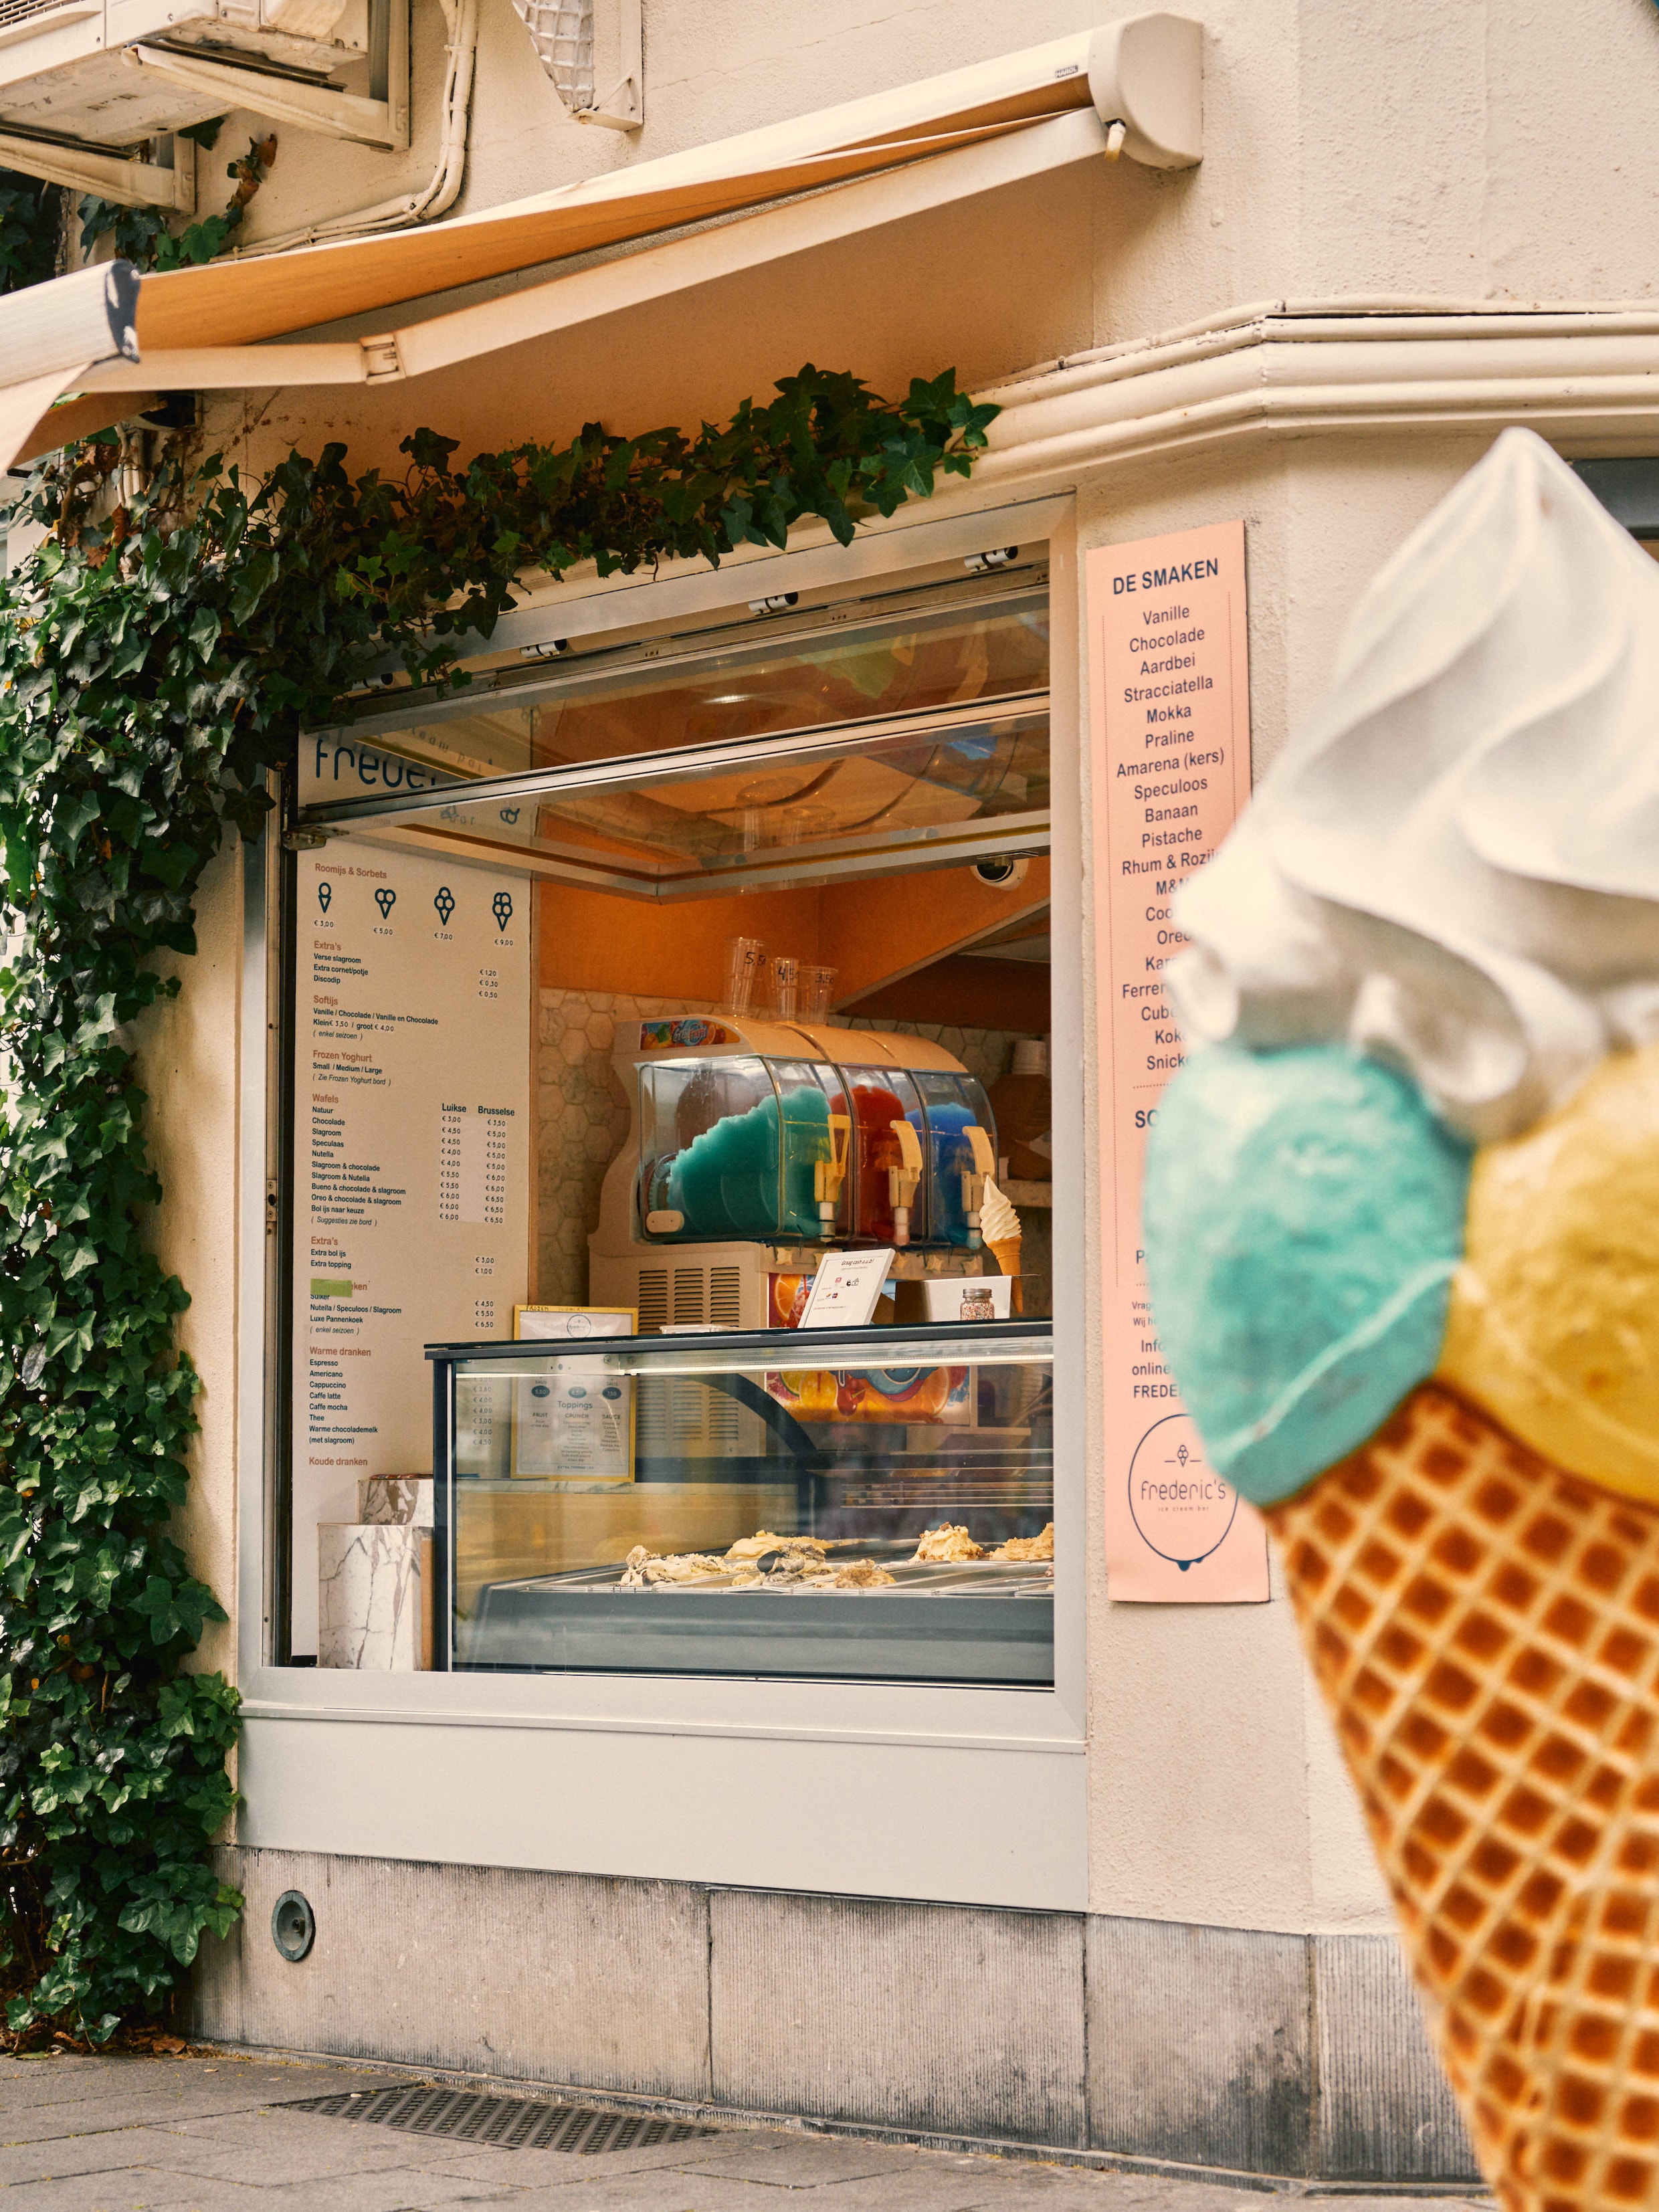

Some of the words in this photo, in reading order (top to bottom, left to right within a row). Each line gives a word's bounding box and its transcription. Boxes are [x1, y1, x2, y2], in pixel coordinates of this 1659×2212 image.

[1114, 575, 1137, 595] DE
[1143, 558, 1217, 589] SMAKEN
[1143, 605, 1189, 625] Vanille
[1130, 627, 1204, 652] Chocolade
[1141, 653, 1195, 675] Aardbei
[1125, 676, 1213, 702] Stracciatella
[1147, 705, 1191, 723] Mokka
[1146, 730, 1194, 748] Praline
[1117, 759, 1179, 777] Amarena
[1185, 748, 1224, 770] (kers)
[1135, 779, 1207, 801] Speculoos
[1145, 805, 1197, 822] Banaan
[1143, 827, 1202, 847] Pistache
[1123, 860, 1161, 875] Rhum
[1167, 855, 1176, 869] &
[1181, 849, 1222, 867] Rozij
[315, 863, 347, 876] Roomijs
[349, 867, 354, 875] &
[357, 868, 387, 878] Sorbets
[1146, 907, 1173, 921] Coo
[314, 940, 341, 950] Extra's
[333, 955, 361, 963] slagroom
[331, 967, 368, 977] cornet/potje
[314, 975, 340, 985] Discodip
[314, 995, 338, 1007] Softijs
[338, 1010, 371, 1019] Chocolade
[407, 1016, 438, 1025] Chocolade
[313, 1049, 339, 1060] Frozen
[342, 1052, 372, 1063] Yoghurt
[365, 1067, 382, 1075] Large
[351, 1076, 371, 1084] Yoghurt
[312, 1094, 338, 1103] Wafels
[442, 1103, 466, 1112] Luikse
[478, 1106, 514, 1116] Brusselse
[312, 1117, 345, 1125] Chocolade
[312, 1128, 341, 1136] Slagroom
[312, 1139, 344, 1147] Speculaas
[312, 1161, 340, 1169] Slagroom
[312, 1172, 340, 1181] Slagroom
[339, 1185, 370, 1193] chocolade
[378, 1187, 405, 1195] slagroom
[334, 1195, 366, 1203] chocolade
[317, 1216, 348, 1225] Suggesties
[311, 1236, 338, 1245] Extra's
[328, 1261, 351, 1270] topping
[373, 1306, 401, 1314] Slagroom
[310, 1346, 337, 1355] Warme
[340, 1347, 371, 1356] dranken
[1133, 1363, 1170, 1376] online
[1133, 1385, 1180, 1398] FREDE
[557, 1401, 593, 1410] Toppings
[324, 1437, 354, 1445] slagroom)
[309, 1457, 334, 1466] Koude
[336, 1457, 368, 1466] dranken
[1141, 1479, 1226, 1500] frederic's
